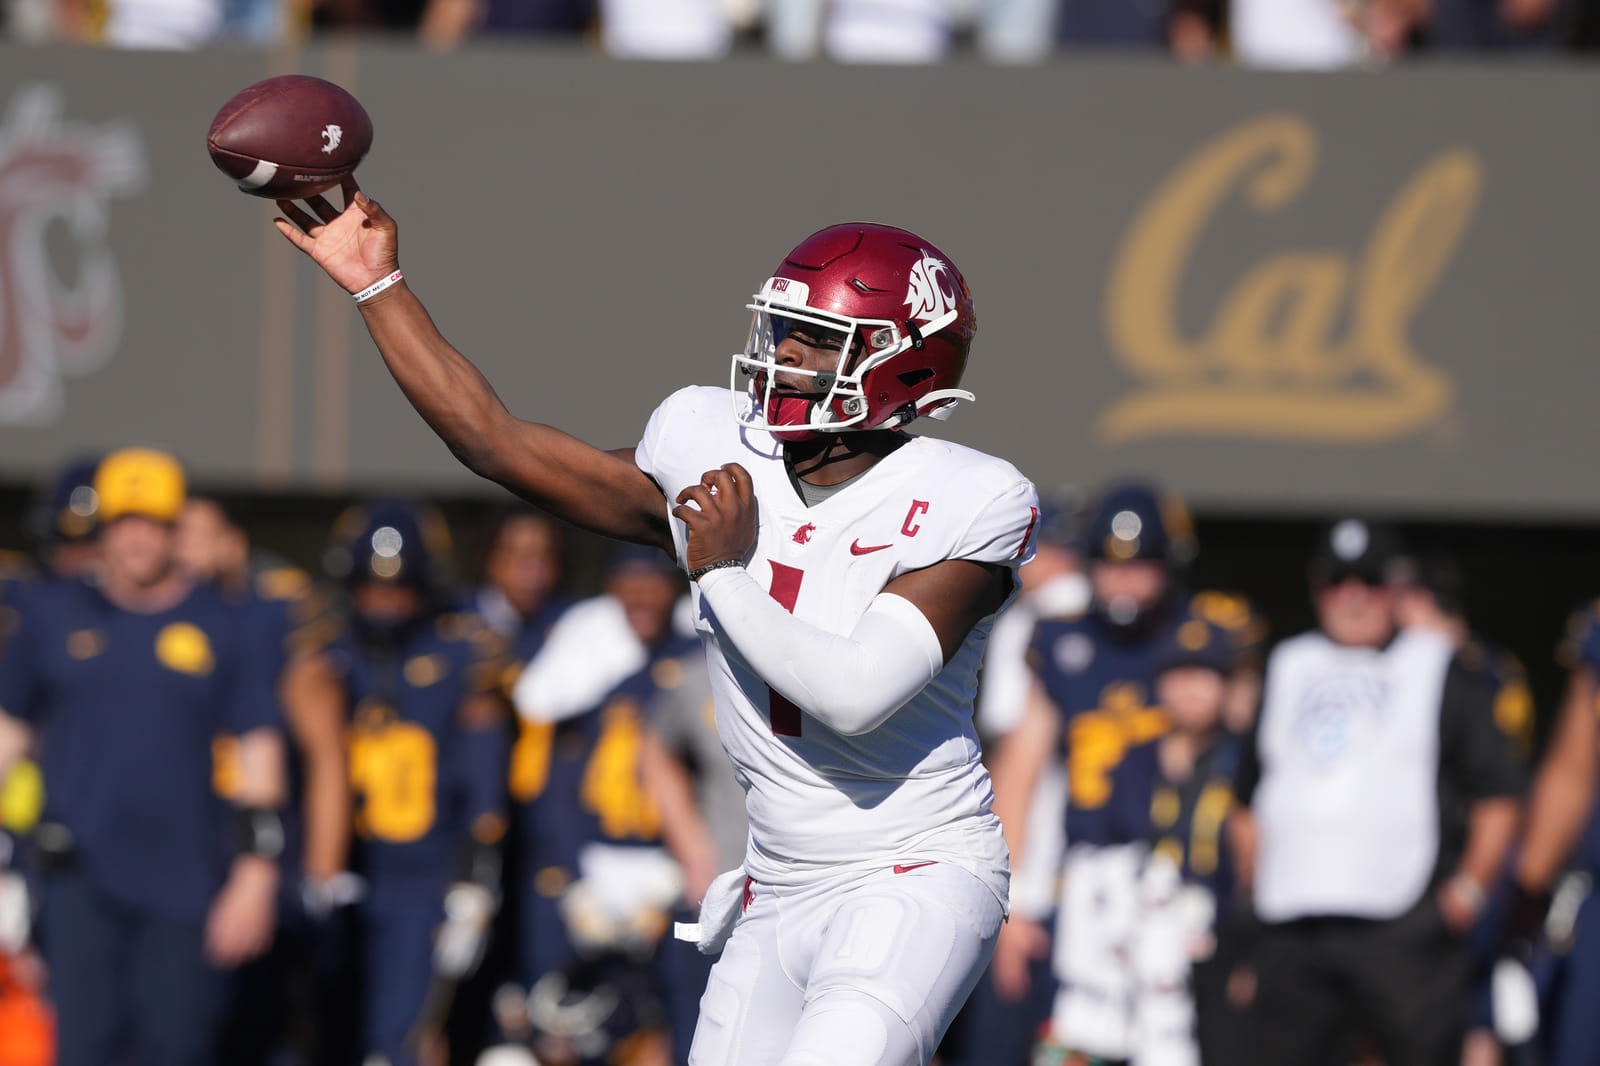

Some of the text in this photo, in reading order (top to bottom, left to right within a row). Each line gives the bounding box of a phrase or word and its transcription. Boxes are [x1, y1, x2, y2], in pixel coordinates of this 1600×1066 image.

[771, 278, 790, 292] WSU
[1098, 115, 1481, 444] Cal
[901, 499, 929, 537] C
